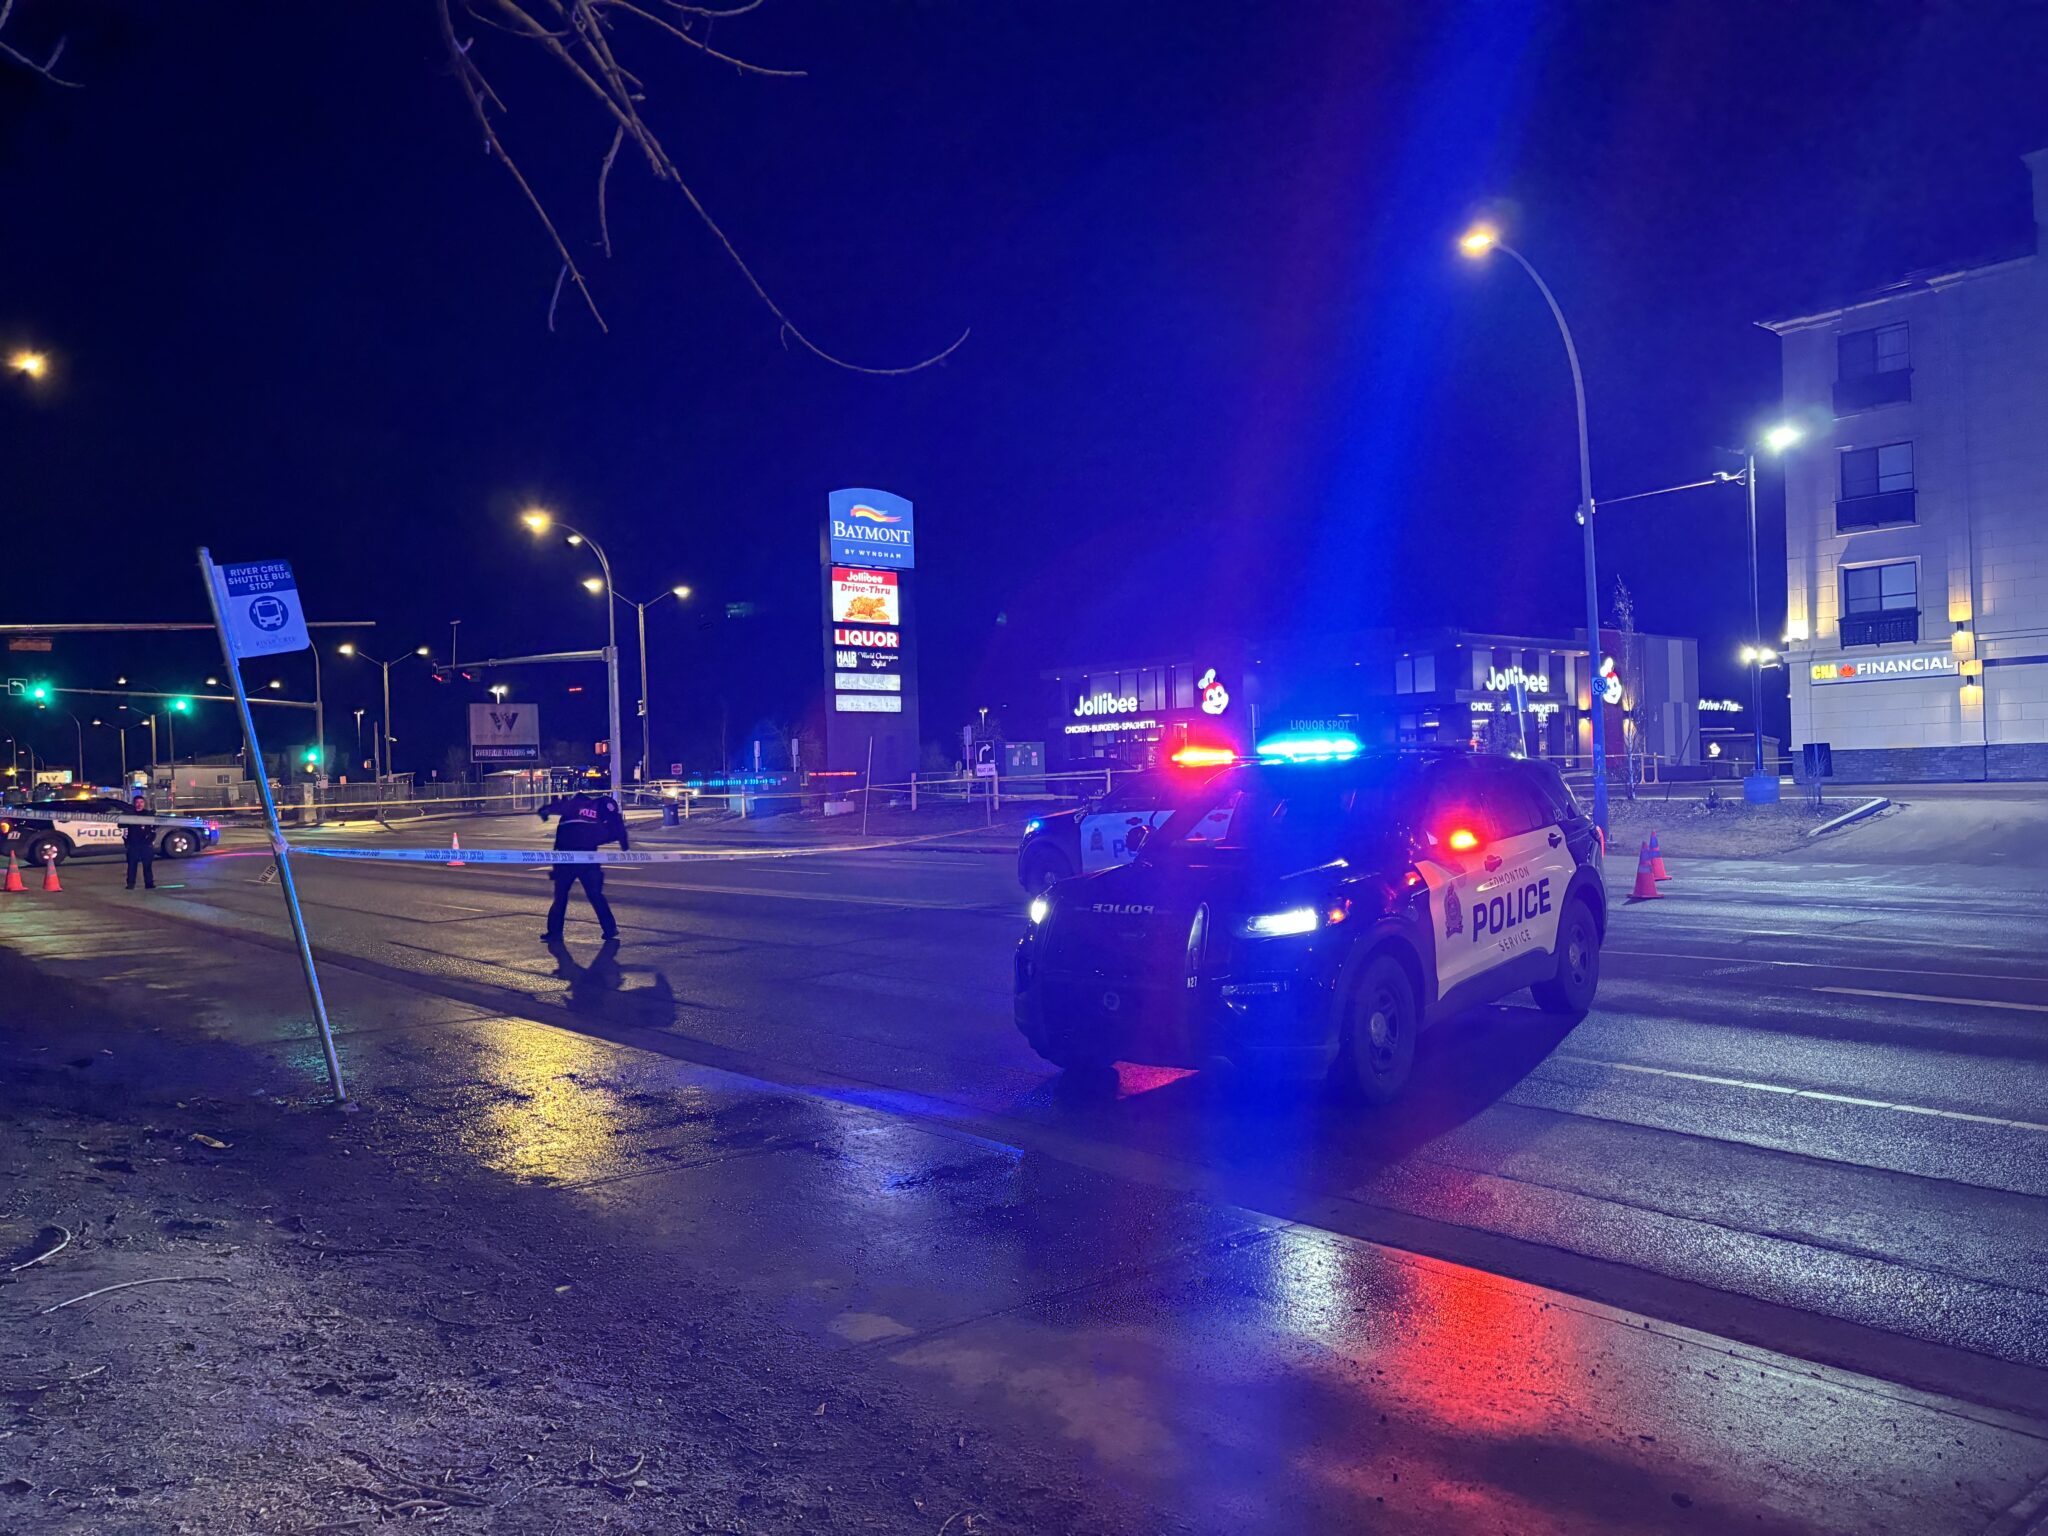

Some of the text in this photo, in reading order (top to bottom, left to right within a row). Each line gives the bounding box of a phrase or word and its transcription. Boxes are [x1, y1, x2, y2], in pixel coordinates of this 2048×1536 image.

[833, 520, 911, 543] BAYMONT
[859, 550, 902, 559] WYNDHAM
[230, 564, 285, 577] RIVER CREE
[846, 571, 883, 584] Jollibee
[228, 571, 291, 585] SHUTTLE BUS
[249, 581, 275, 591] STOP
[840, 583, 891, 595] Drive-Thru
[834, 629, 898, 648] LIQUOR
[1857, 656, 1954, 675] FINANCIAL
[1074, 692, 1138, 717] Jollibee
[1290, 719, 1350, 732] LIQUOR SPOT
[1472, 877, 1551, 943] POLICE
[1498, 929, 1532, 952] SERVICE
